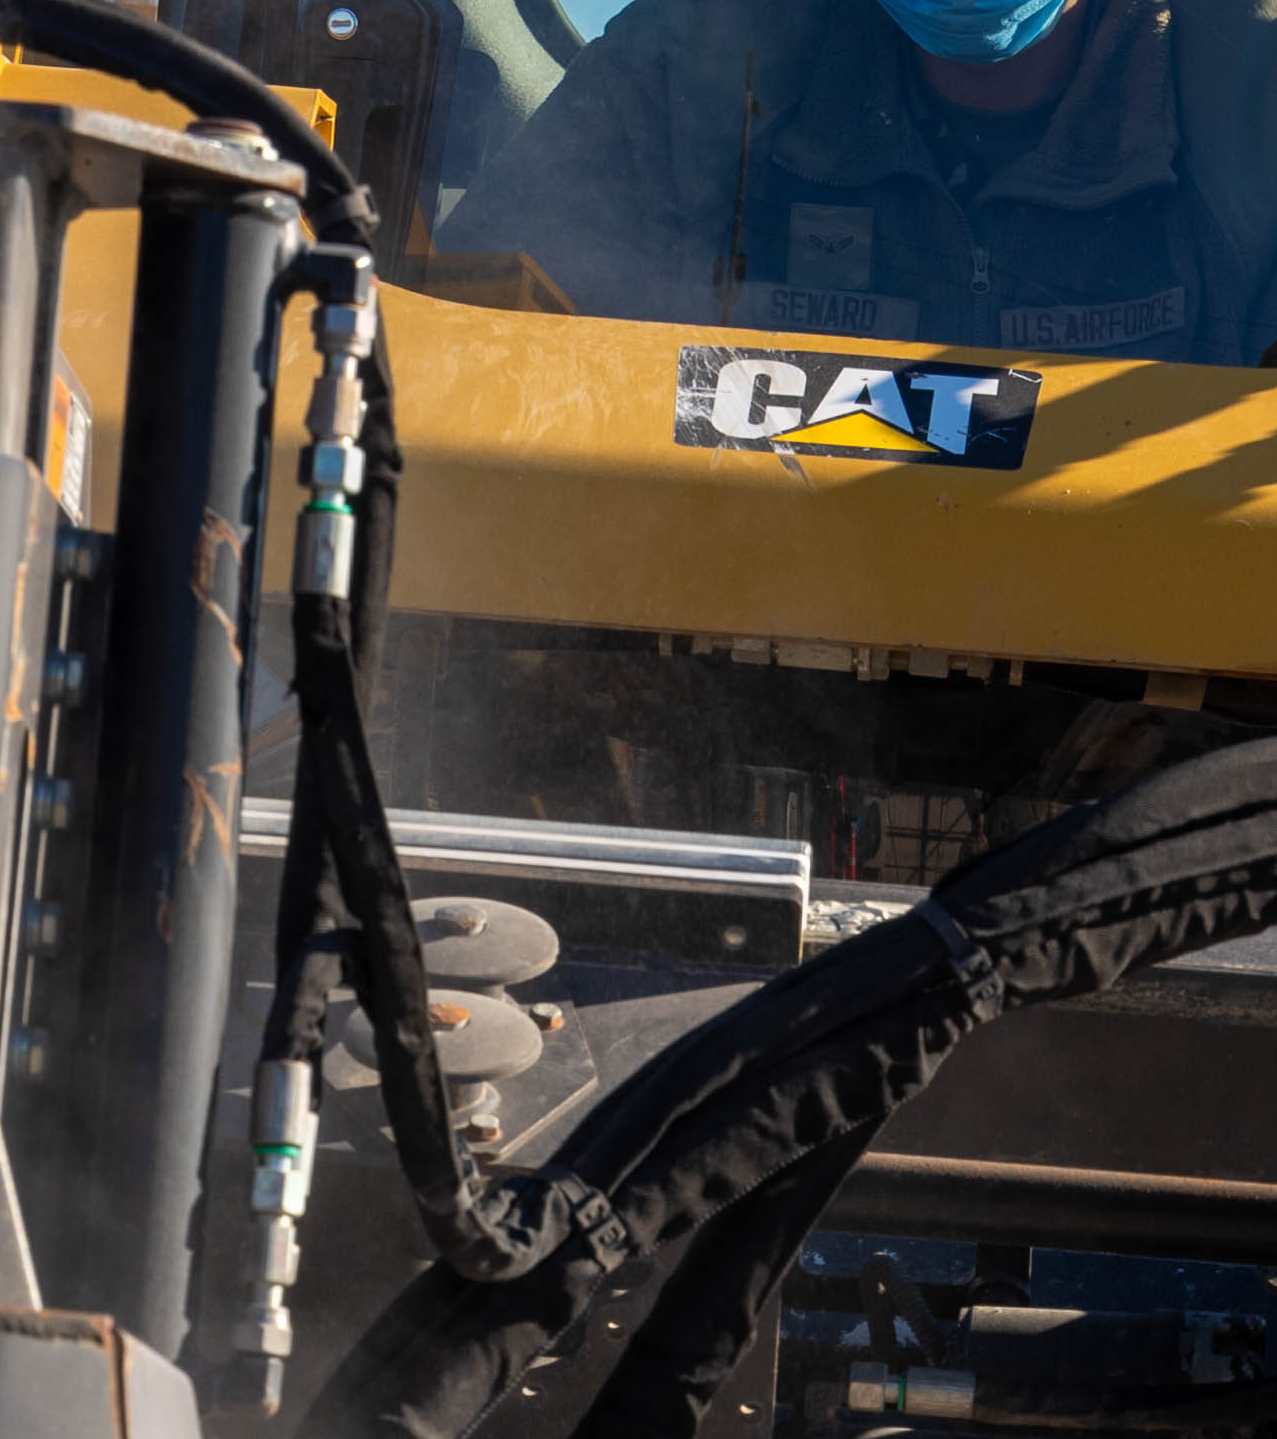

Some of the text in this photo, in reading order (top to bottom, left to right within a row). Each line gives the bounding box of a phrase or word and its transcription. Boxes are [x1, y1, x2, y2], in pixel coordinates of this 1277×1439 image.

[772, 289, 876, 332] SEWARD
[1012, 296, 1173, 347] U.S. AIR FORCE
[712, 359, 999, 455] CAT
